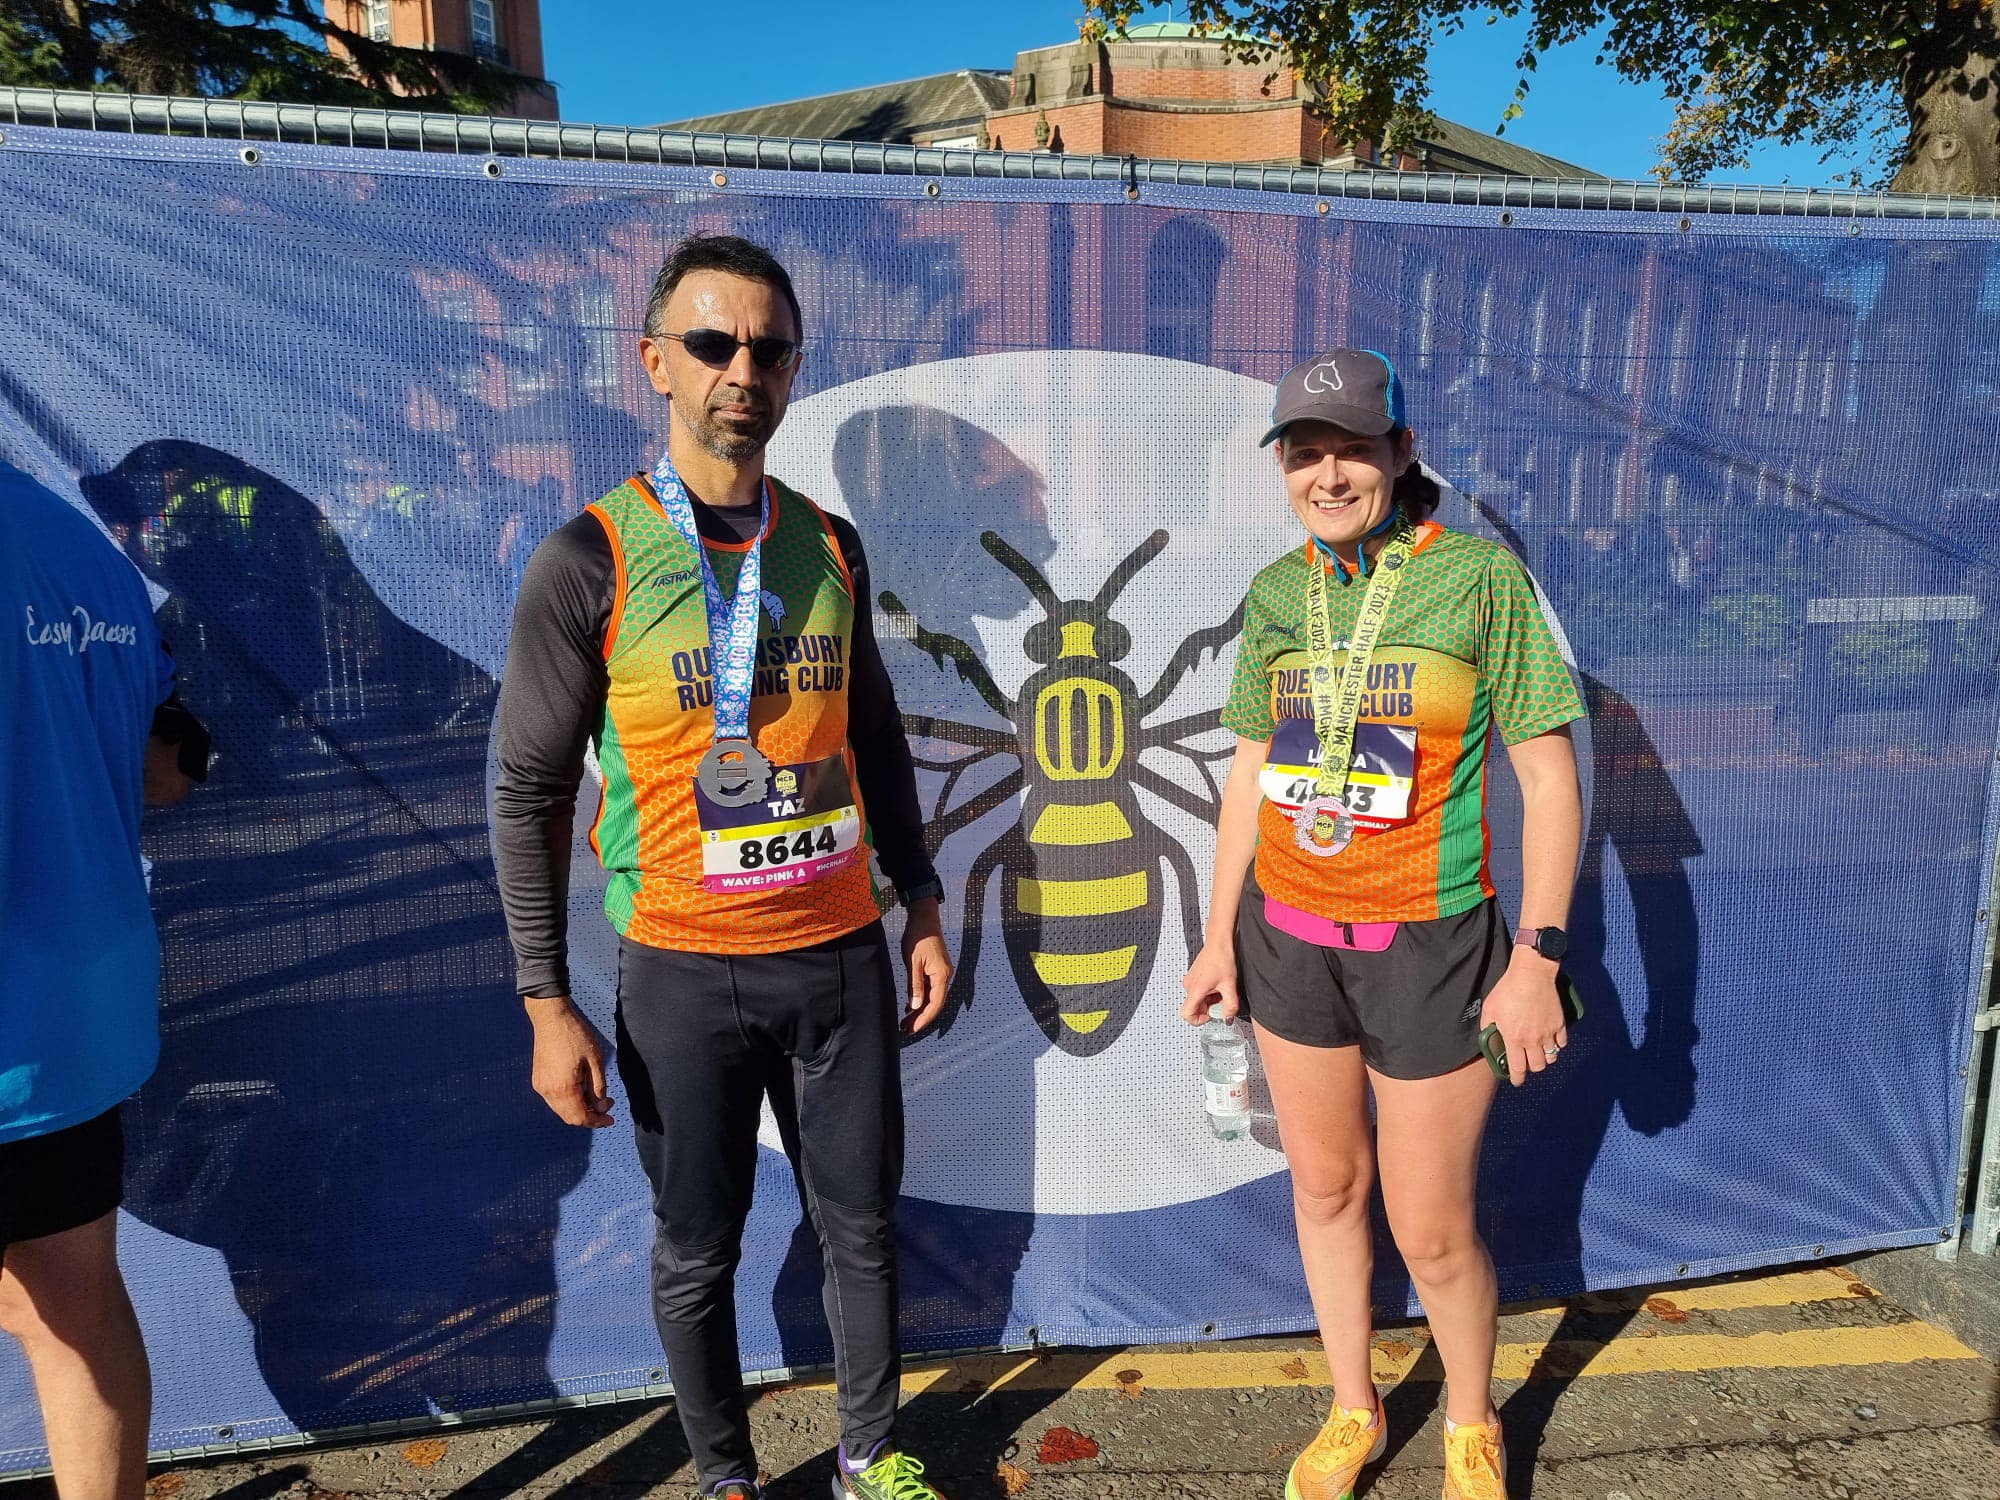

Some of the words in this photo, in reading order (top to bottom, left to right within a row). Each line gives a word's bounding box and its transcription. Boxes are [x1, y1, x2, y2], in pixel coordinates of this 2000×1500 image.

[1311, 622, 1326, 652] 2023
[1333, 656, 1366, 746] MANCHESTER
[1356, 618, 1377, 652] HALF
[1367, 584, 1390, 616] 2023
[797, 666, 844, 693] CLUB
[1359, 692, 1413, 718] CLUB
[768, 797, 806, 818] TAZ
[739, 825, 837, 869] 8644
[722, 875, 764, 888] WAVE:
[766, 870, 795, 883] PINK
[797, 868, 807, 878] A
